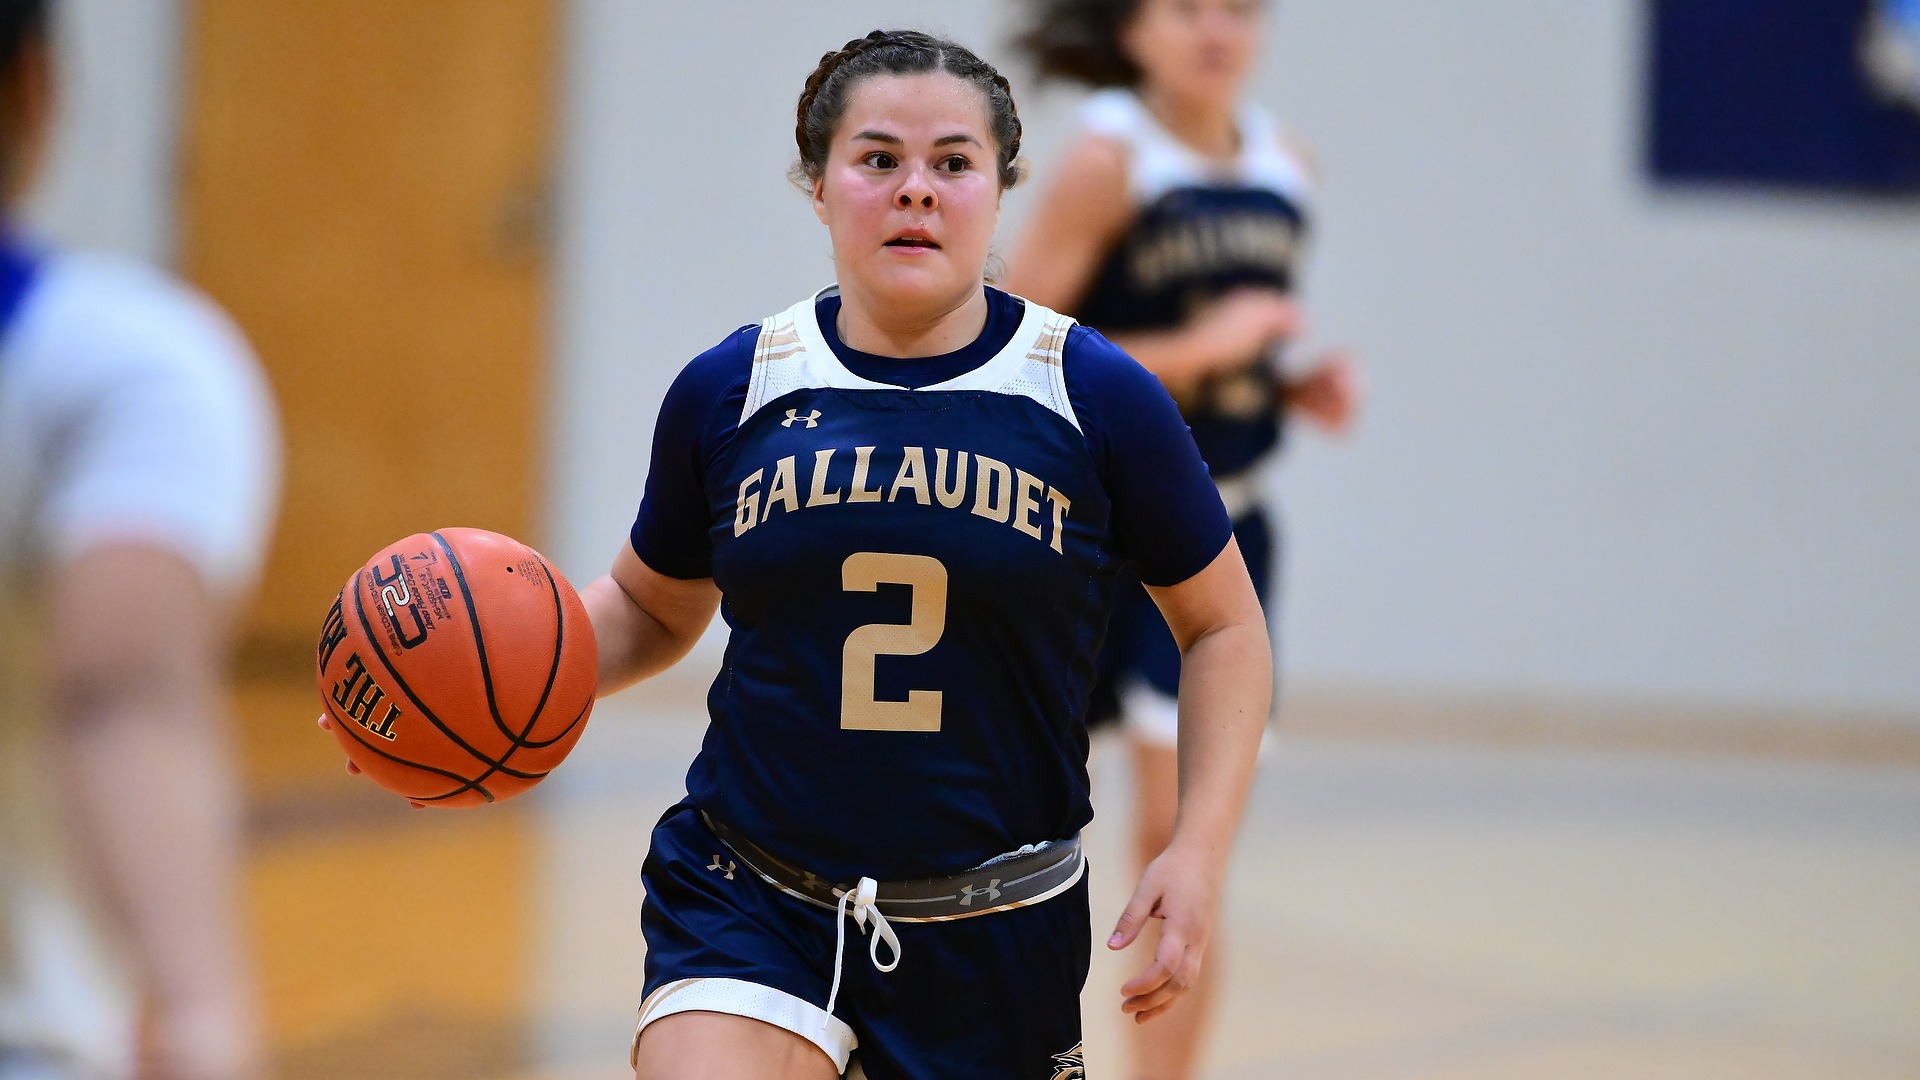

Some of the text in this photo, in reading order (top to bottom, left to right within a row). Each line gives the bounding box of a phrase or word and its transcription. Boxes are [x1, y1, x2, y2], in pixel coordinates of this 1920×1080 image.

[734, 446, 1071, 555] GALLAUDET
[840, 551, 948, 731] 2
[332, 652, 402, 742] THE
